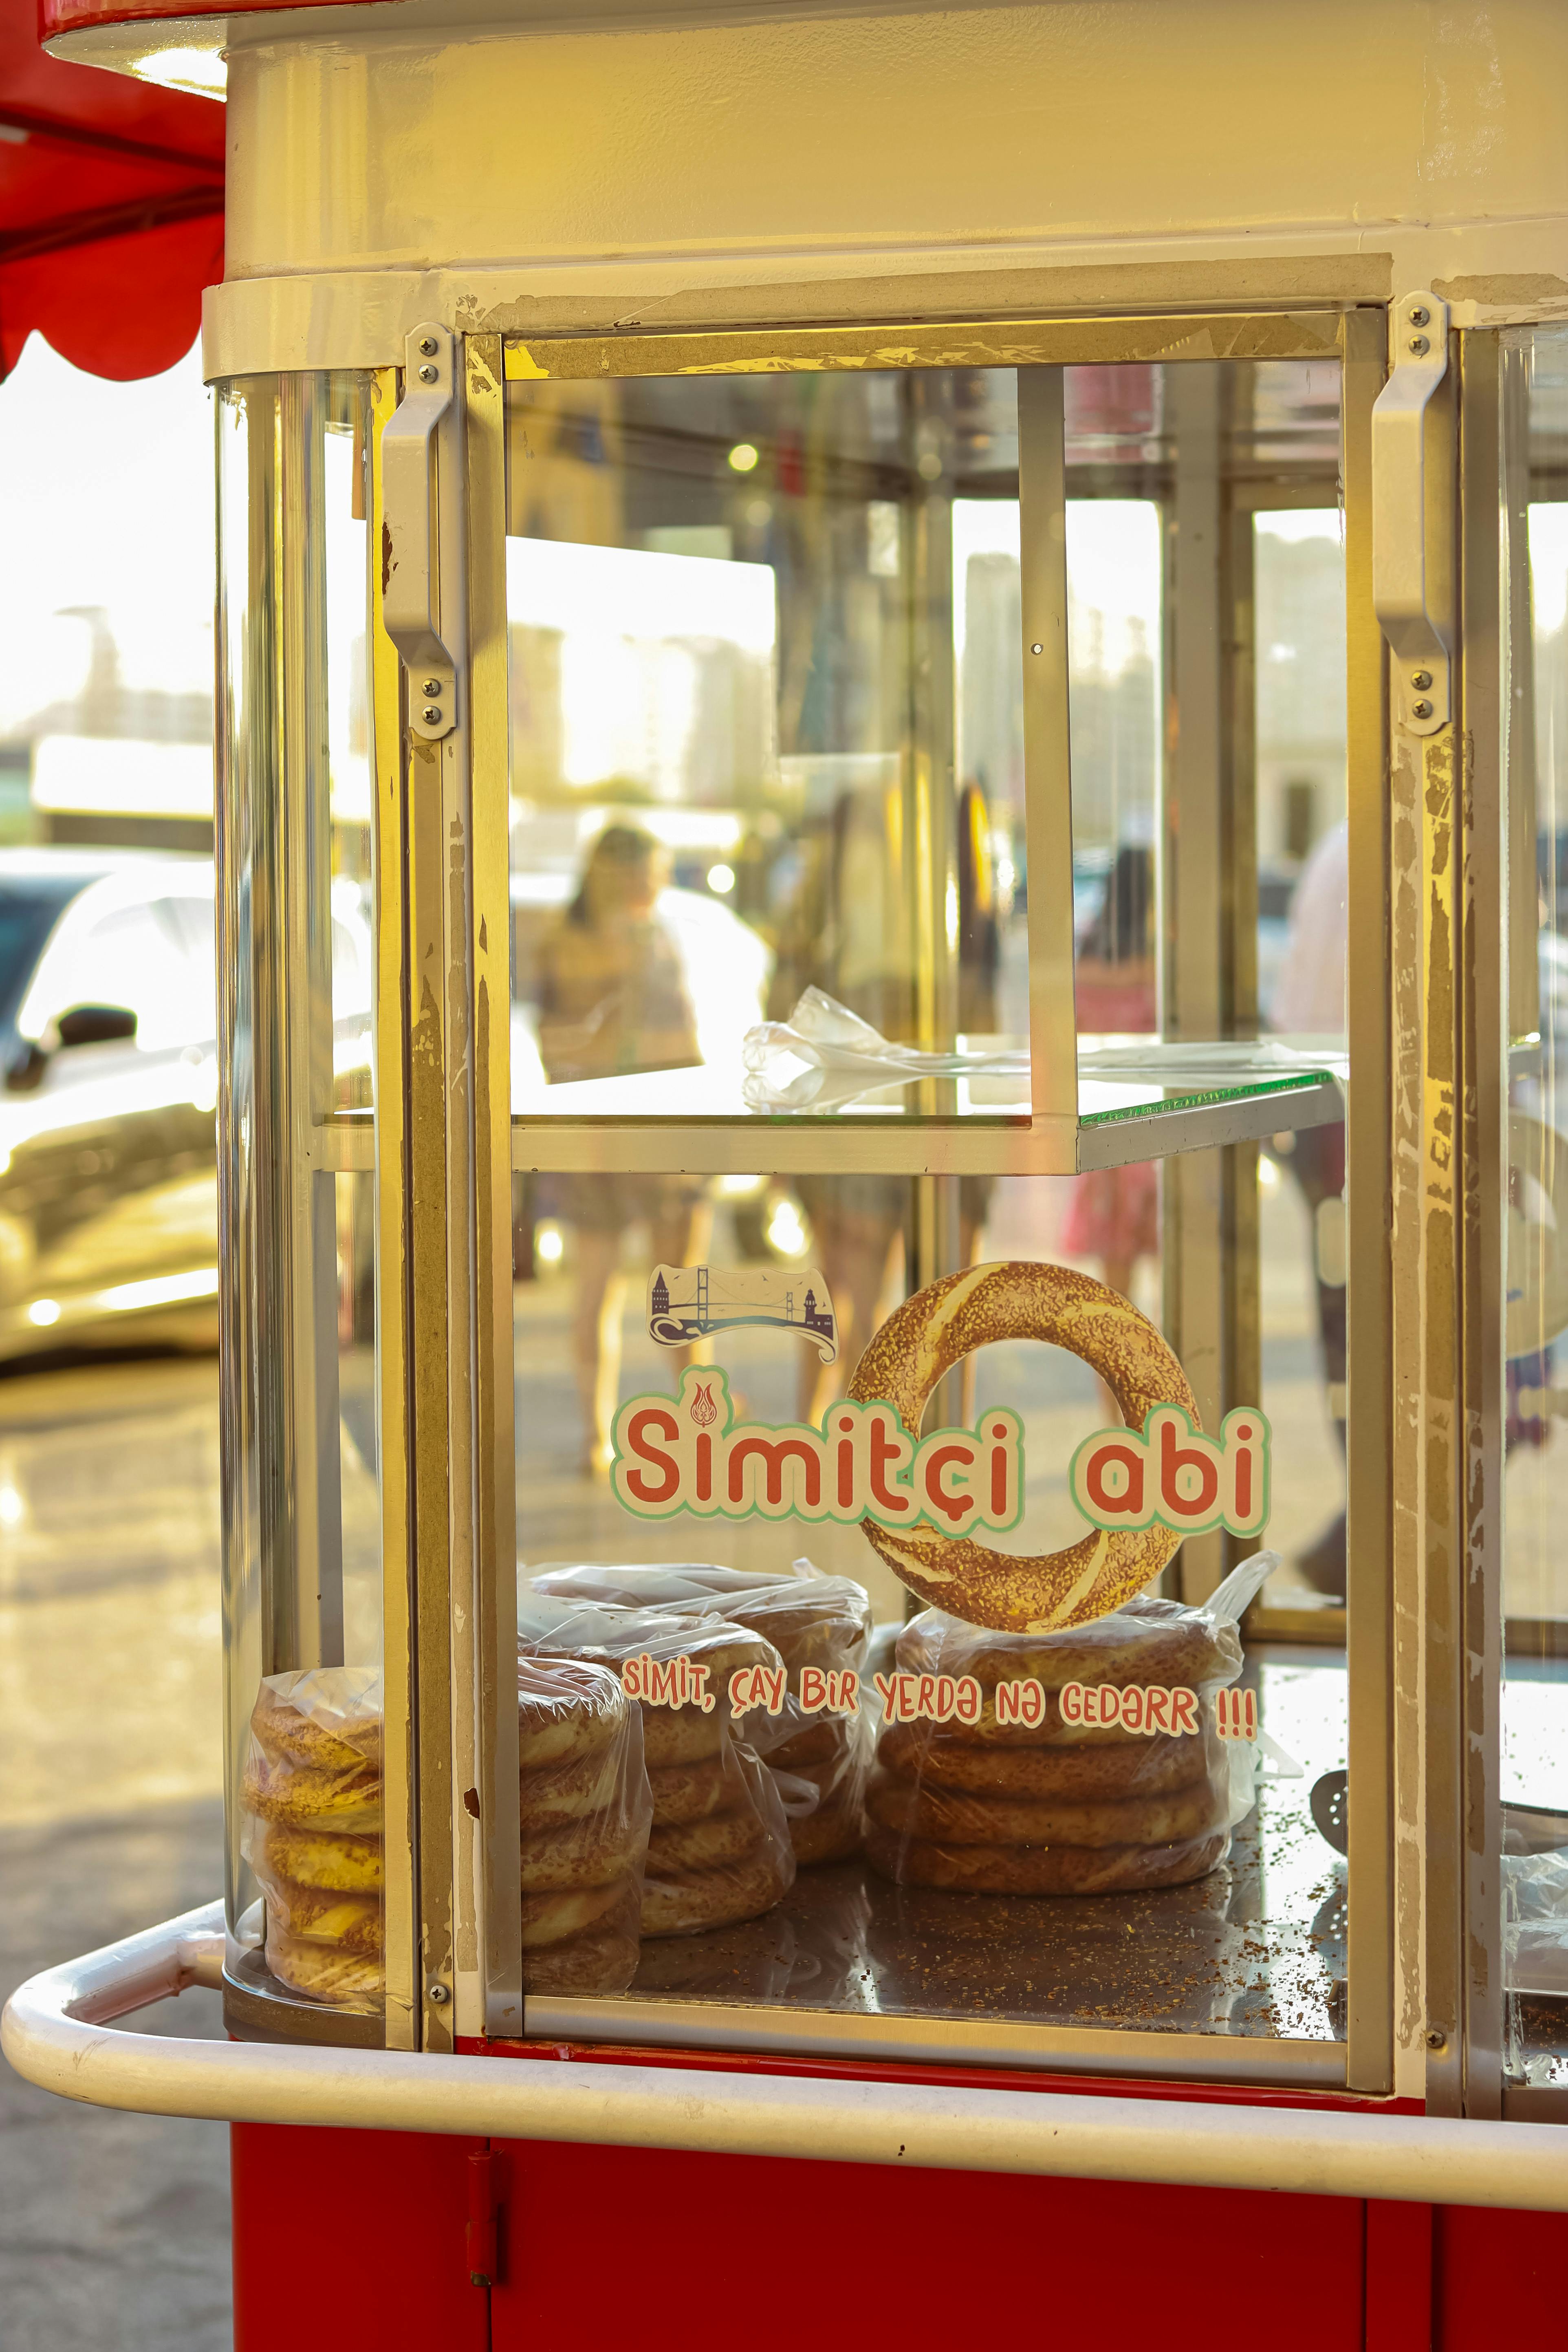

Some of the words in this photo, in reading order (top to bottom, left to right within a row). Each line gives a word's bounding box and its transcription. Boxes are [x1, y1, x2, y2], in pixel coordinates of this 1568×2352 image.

[626, 1382, 1007, 1521] Simitçi
[1086, 1421, 1253, 1519] abi
[733, 1666, 783, 1713] ÇAY
[1219, 1690, 1253, 1738] !!!
